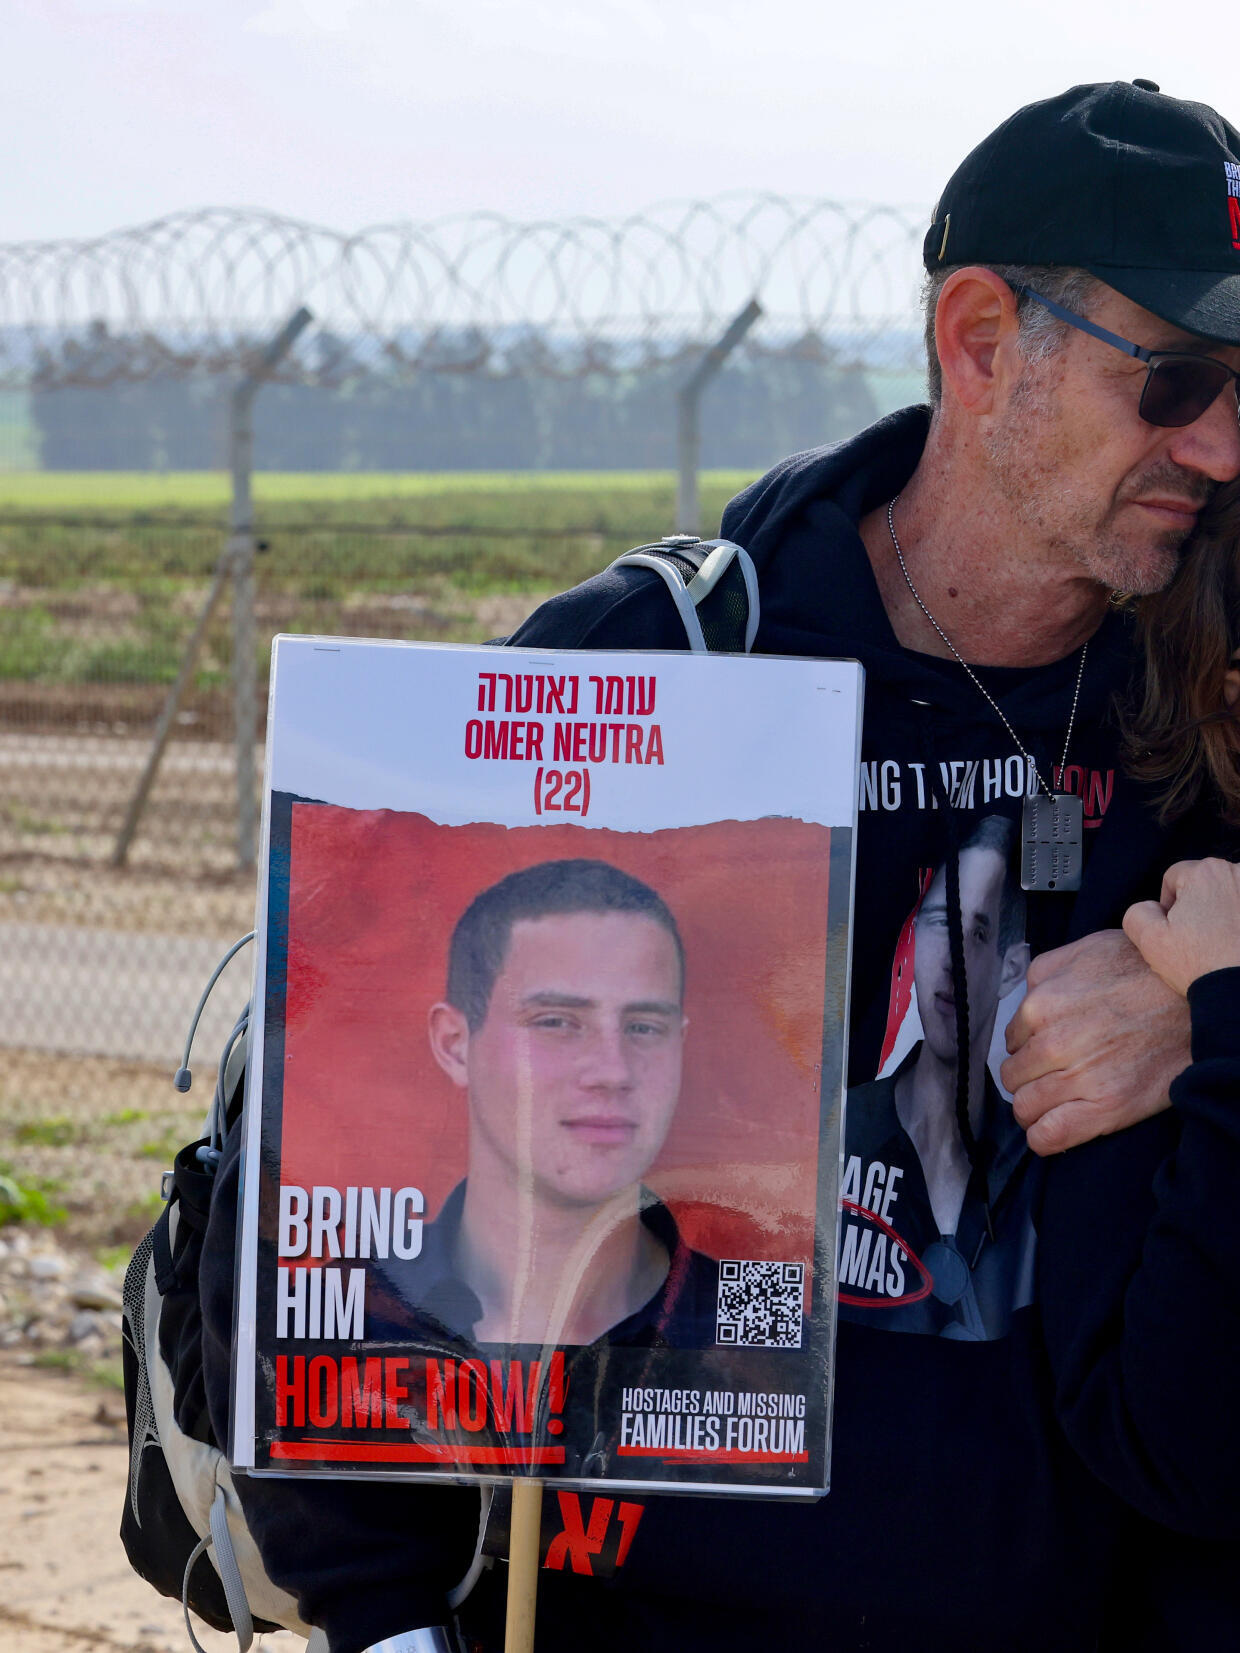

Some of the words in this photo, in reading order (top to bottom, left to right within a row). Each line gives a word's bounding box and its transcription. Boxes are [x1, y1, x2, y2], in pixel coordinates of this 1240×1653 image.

[478, 672, 579, 714] נאוטרה
[589, 675, 656, 715] עומר
[465, 719, 544, 761] OMER
[553, 722, 664, 765] NEUTRA
[534, 767, 591, 816] (22)
[858, 760, 902, 811] NG
[840, 1155, 904, 1226] AGE
[277, 1185, 424, 1260] BRING
[838, 1224, 908, 1298] MAS
[276, 1267, 366, 1340] HIM
[275, 1355, 411, 1429] HOME
[426, 1351, 566, 1435] NOW!
[621, 1387, 700, 1414] HOSTAGES
[703, 1390, 734, 1415] AND
[737, 1392, 806, 1418] MISSING
[620, 1413, 720, 1451] FAMILIES
[726, 1417, 805, 1454] FORUM
